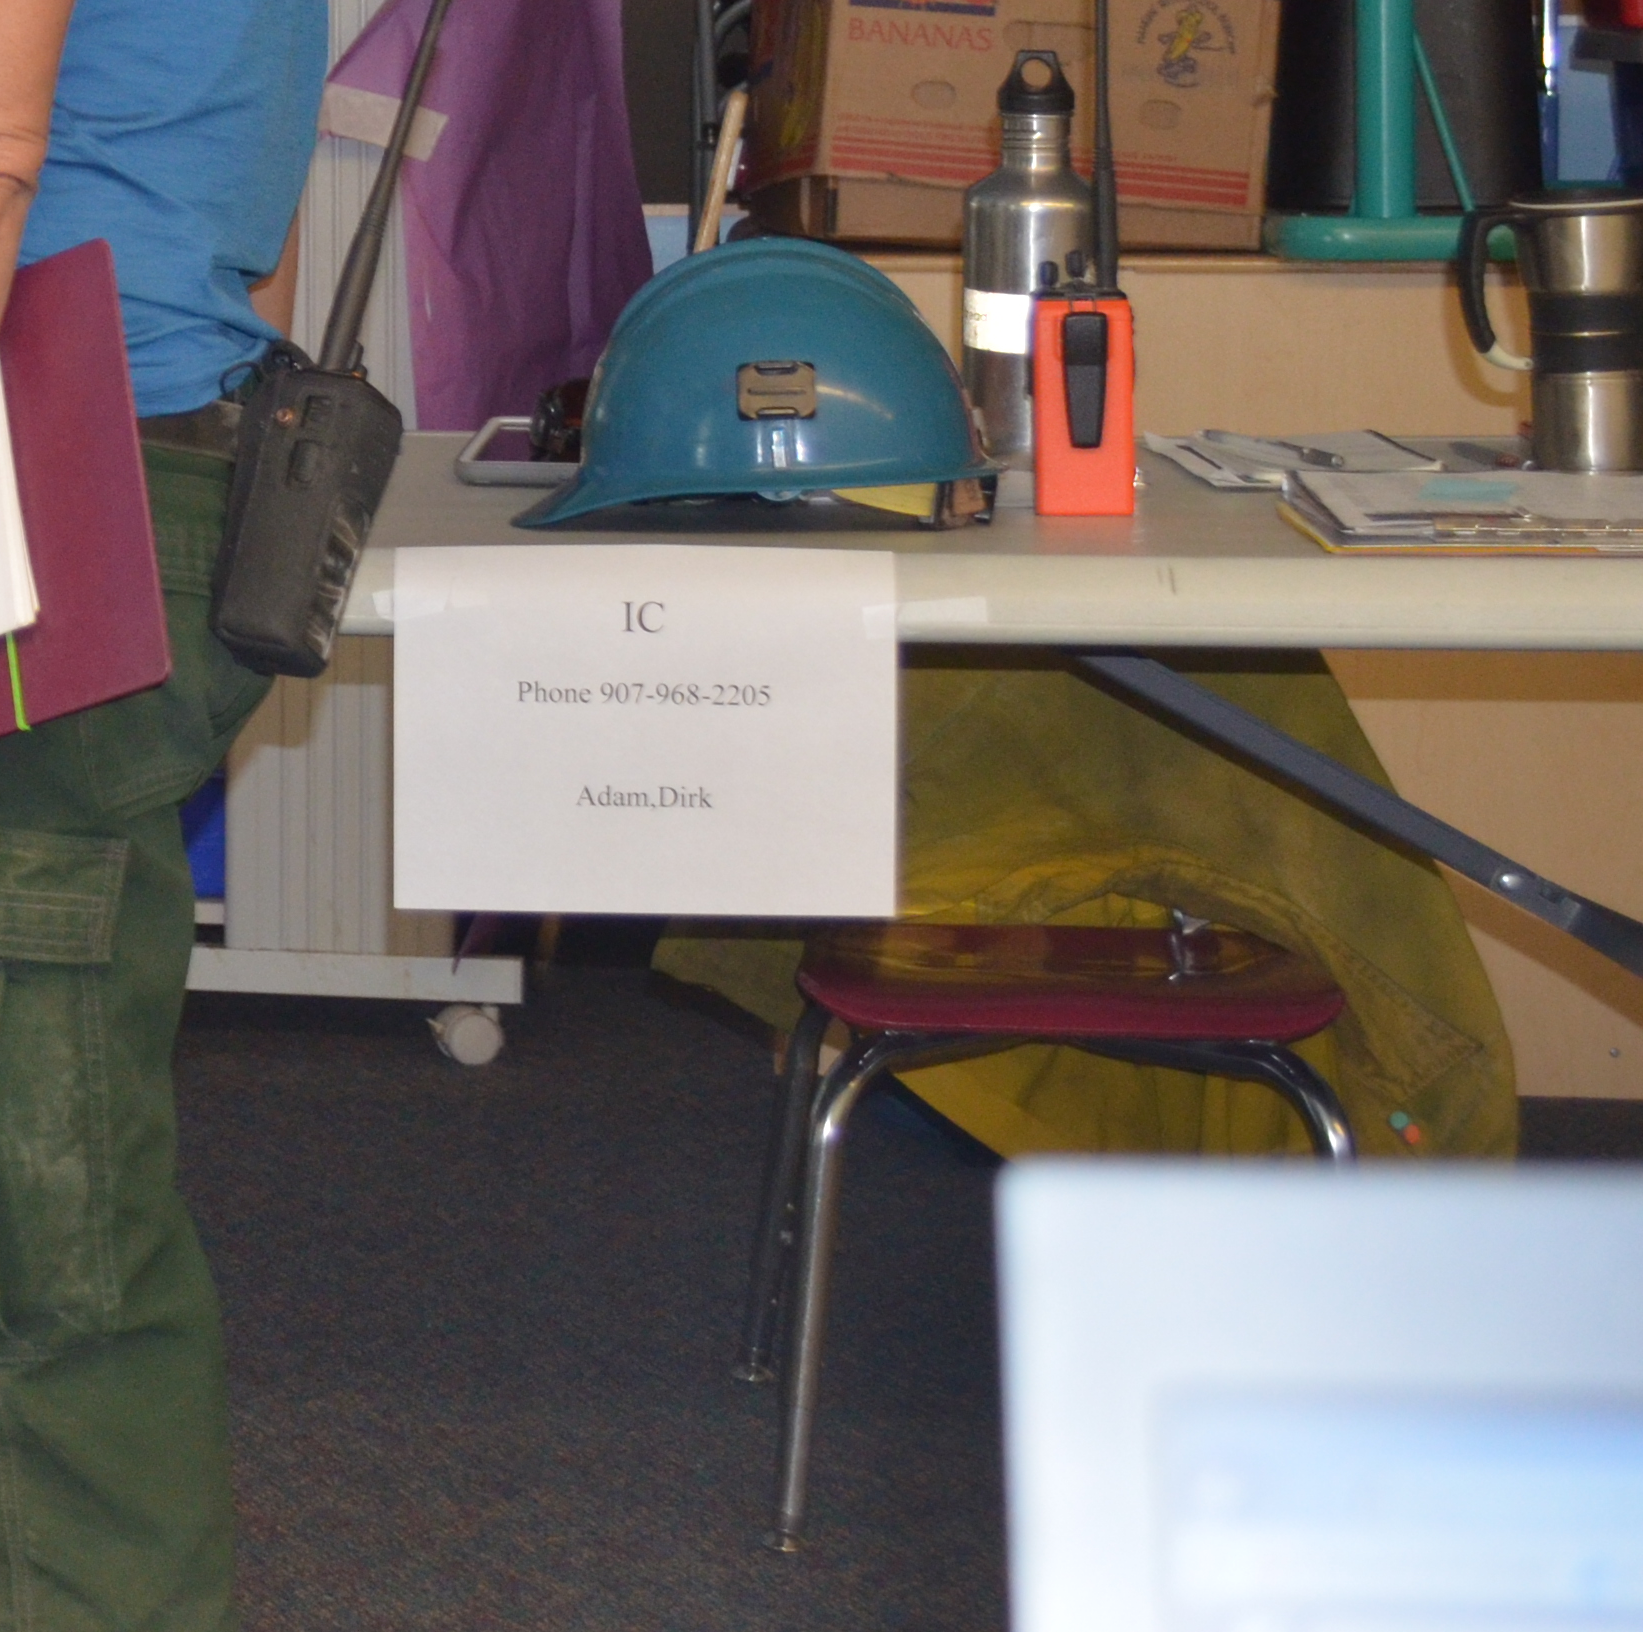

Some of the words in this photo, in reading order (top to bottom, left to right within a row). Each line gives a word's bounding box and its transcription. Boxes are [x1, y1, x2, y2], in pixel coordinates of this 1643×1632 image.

[847, 18, 994, 52] BANANAS
[620, 600, 666, 634] IC
[516, 681, 592, 706] Phone
[600, 681, 772, 707] 907-968-2205
[575, 785, 714, 811] Adam,Dirk
